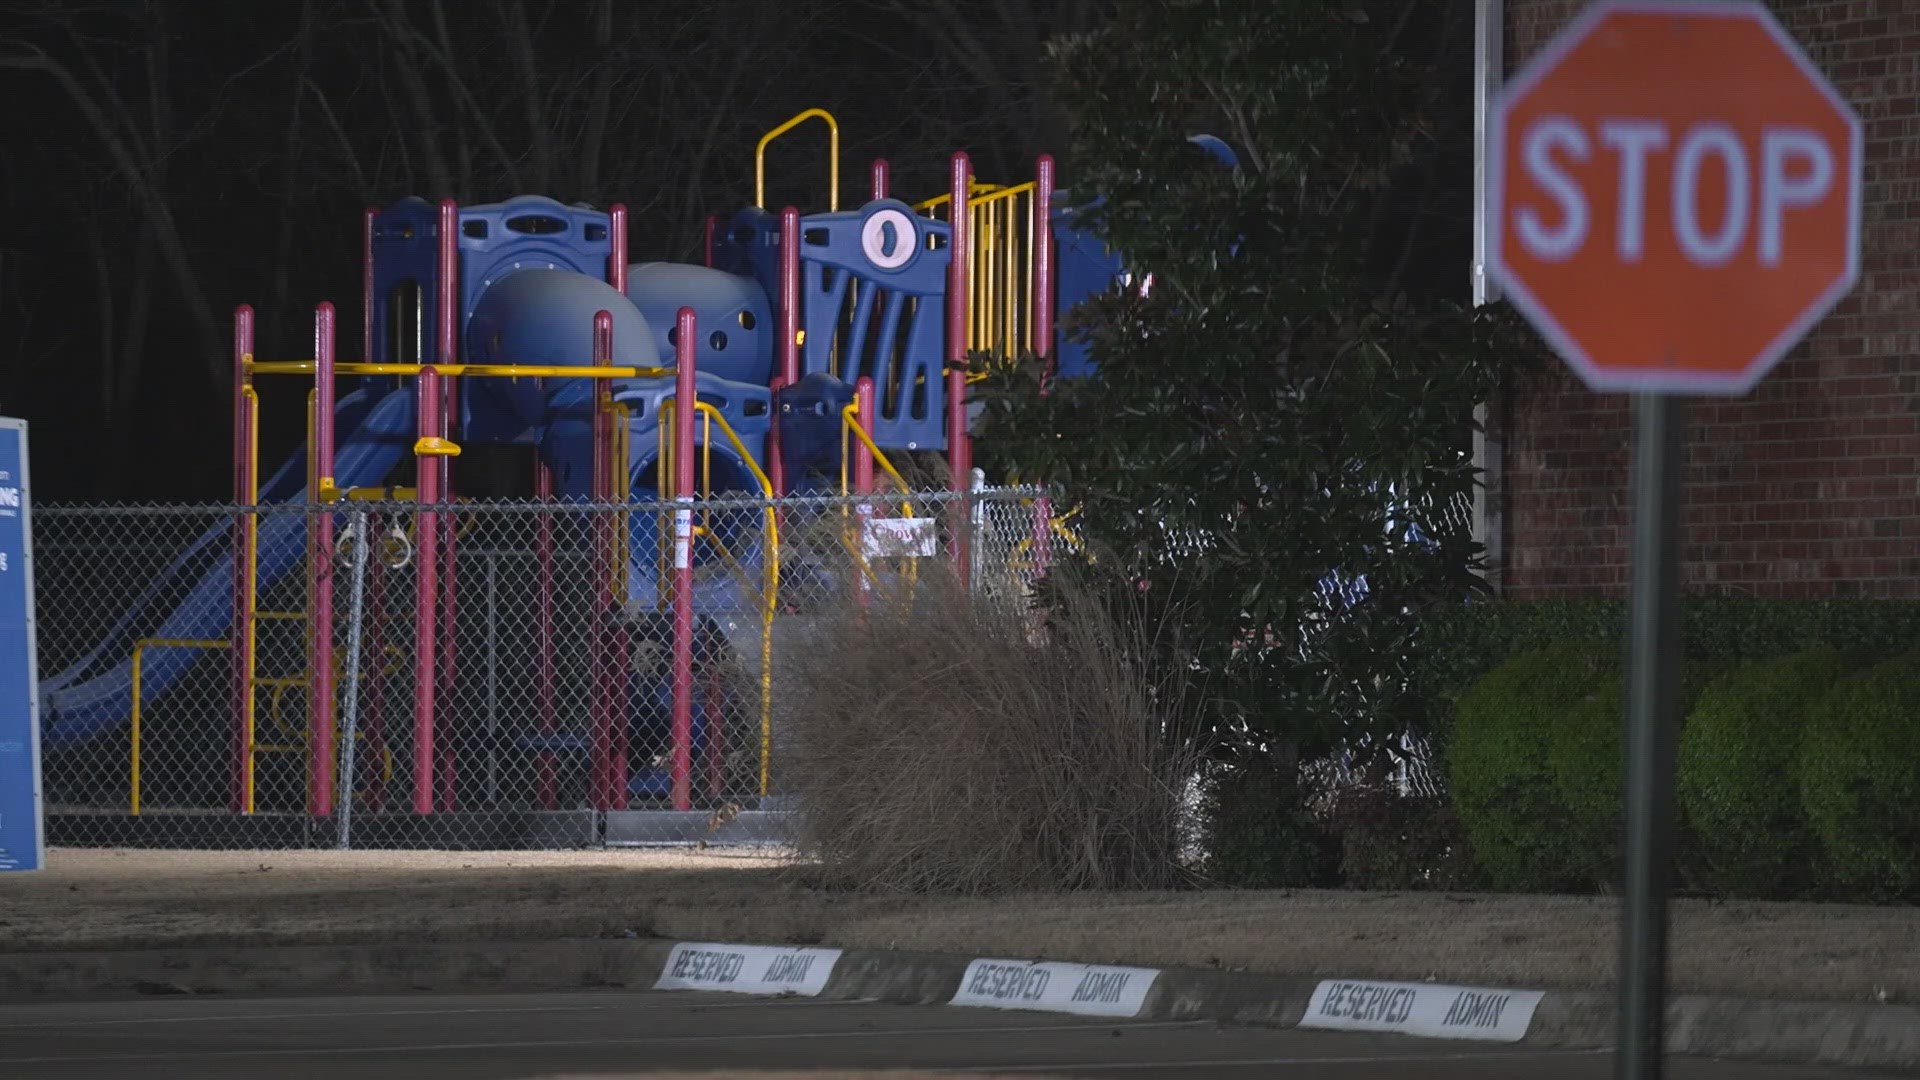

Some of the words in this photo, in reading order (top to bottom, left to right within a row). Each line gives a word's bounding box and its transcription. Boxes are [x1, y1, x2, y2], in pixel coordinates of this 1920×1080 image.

[1514, 113, 1836, 270] STOP
[671, 949, 745, 984] RESERVED
[761, 954, 817, 984] ADMIN
[968, 964, 1051, 1001] RESERVED
[1071, 971, 1131, 1004] ADMIN
[1319, 983, 1417, 1025] RESERVED
[1442, 991, 1510, 1029] ADMIN
